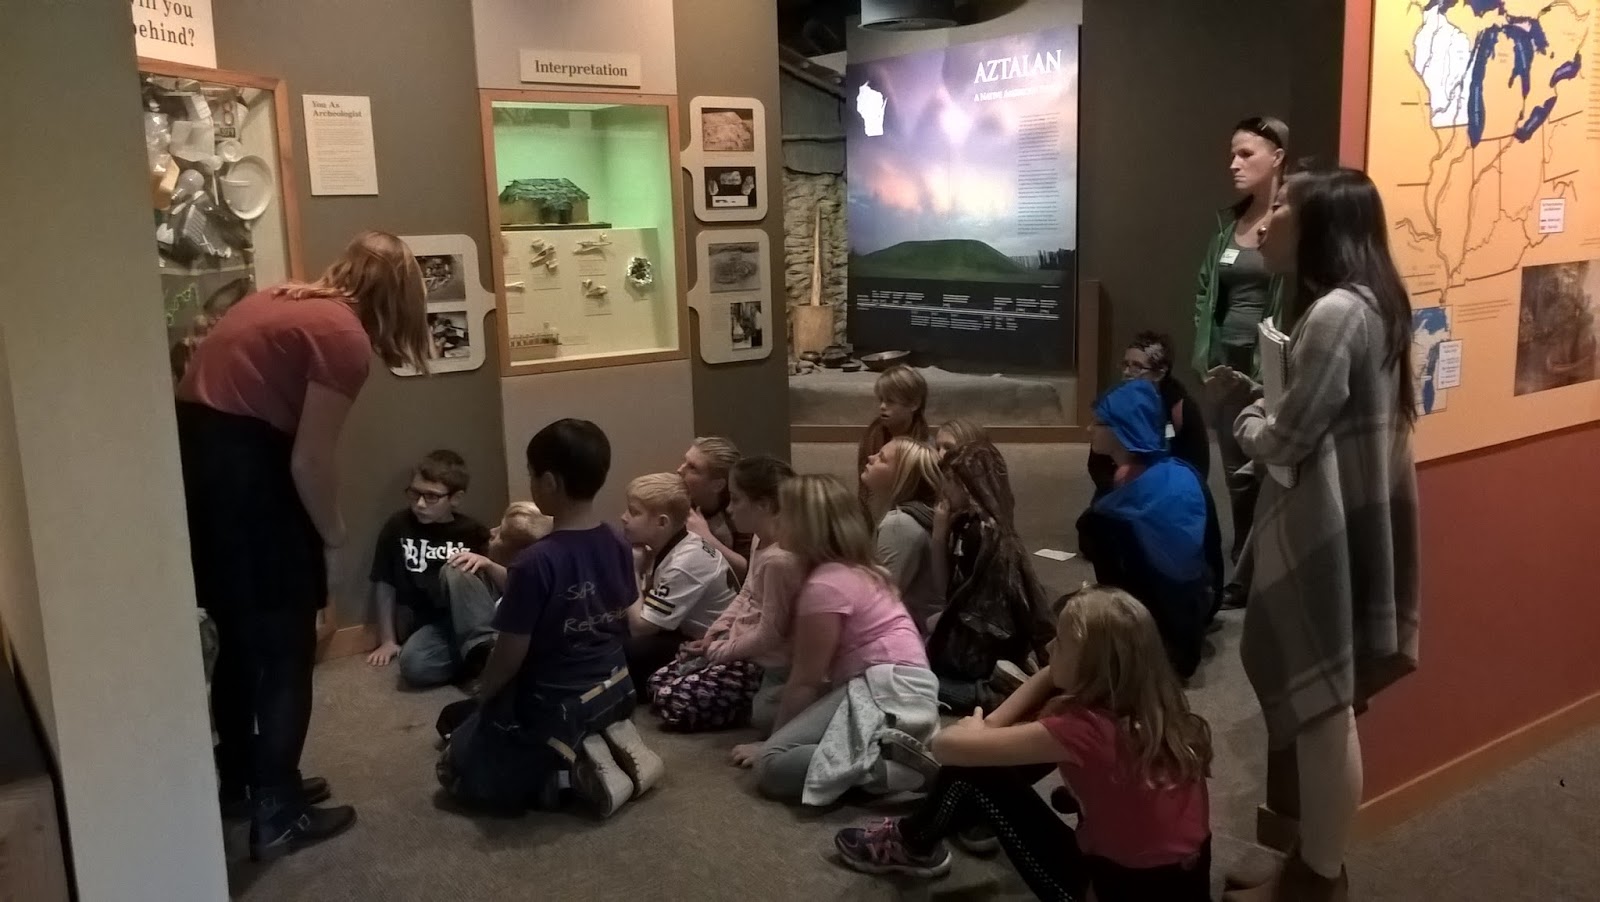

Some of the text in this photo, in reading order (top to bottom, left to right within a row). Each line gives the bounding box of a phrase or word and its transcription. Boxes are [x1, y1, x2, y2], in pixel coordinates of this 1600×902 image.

[163, 0, 193, 19] you
[133, 20, 195, 47] ehind?
[535, 60, 628, 77] Interpretation
[974, 49, 1062, 84] AZTALAN
[312, 101, 326, 109] You
[313, 110, 363, 119] Archeologist
